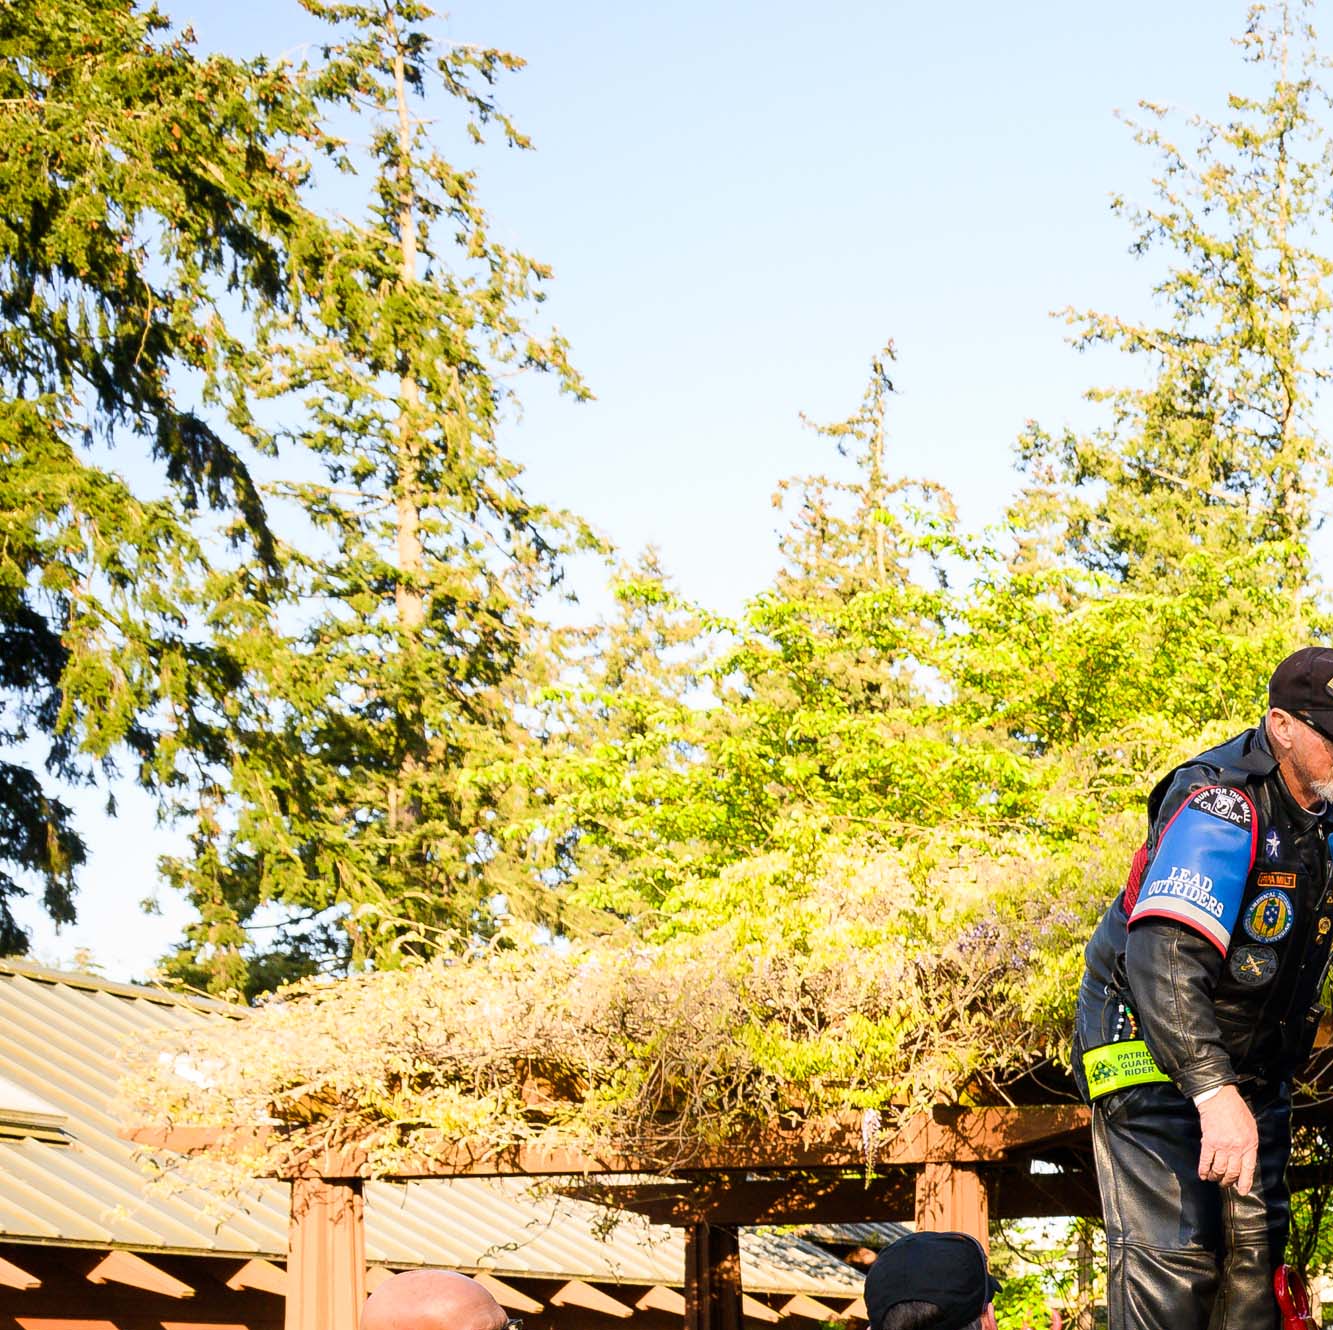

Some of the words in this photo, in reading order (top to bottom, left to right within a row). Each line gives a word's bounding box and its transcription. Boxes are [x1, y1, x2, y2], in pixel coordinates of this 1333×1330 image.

[1194, 790, 1210, 804] RUN
[1229, 790, 1244, 803] THE
[1200, 801, 1211, 811] CA
[1230, 812, 1243, 823] DC
[1168, 866, 1213, 893] LEAD
[1148, 880, 1224, 918] OUTRIDERS
[1117, 1051, 1153, 1061] PATRIO
[1124, 1066, 1154, 1077] RIDER
